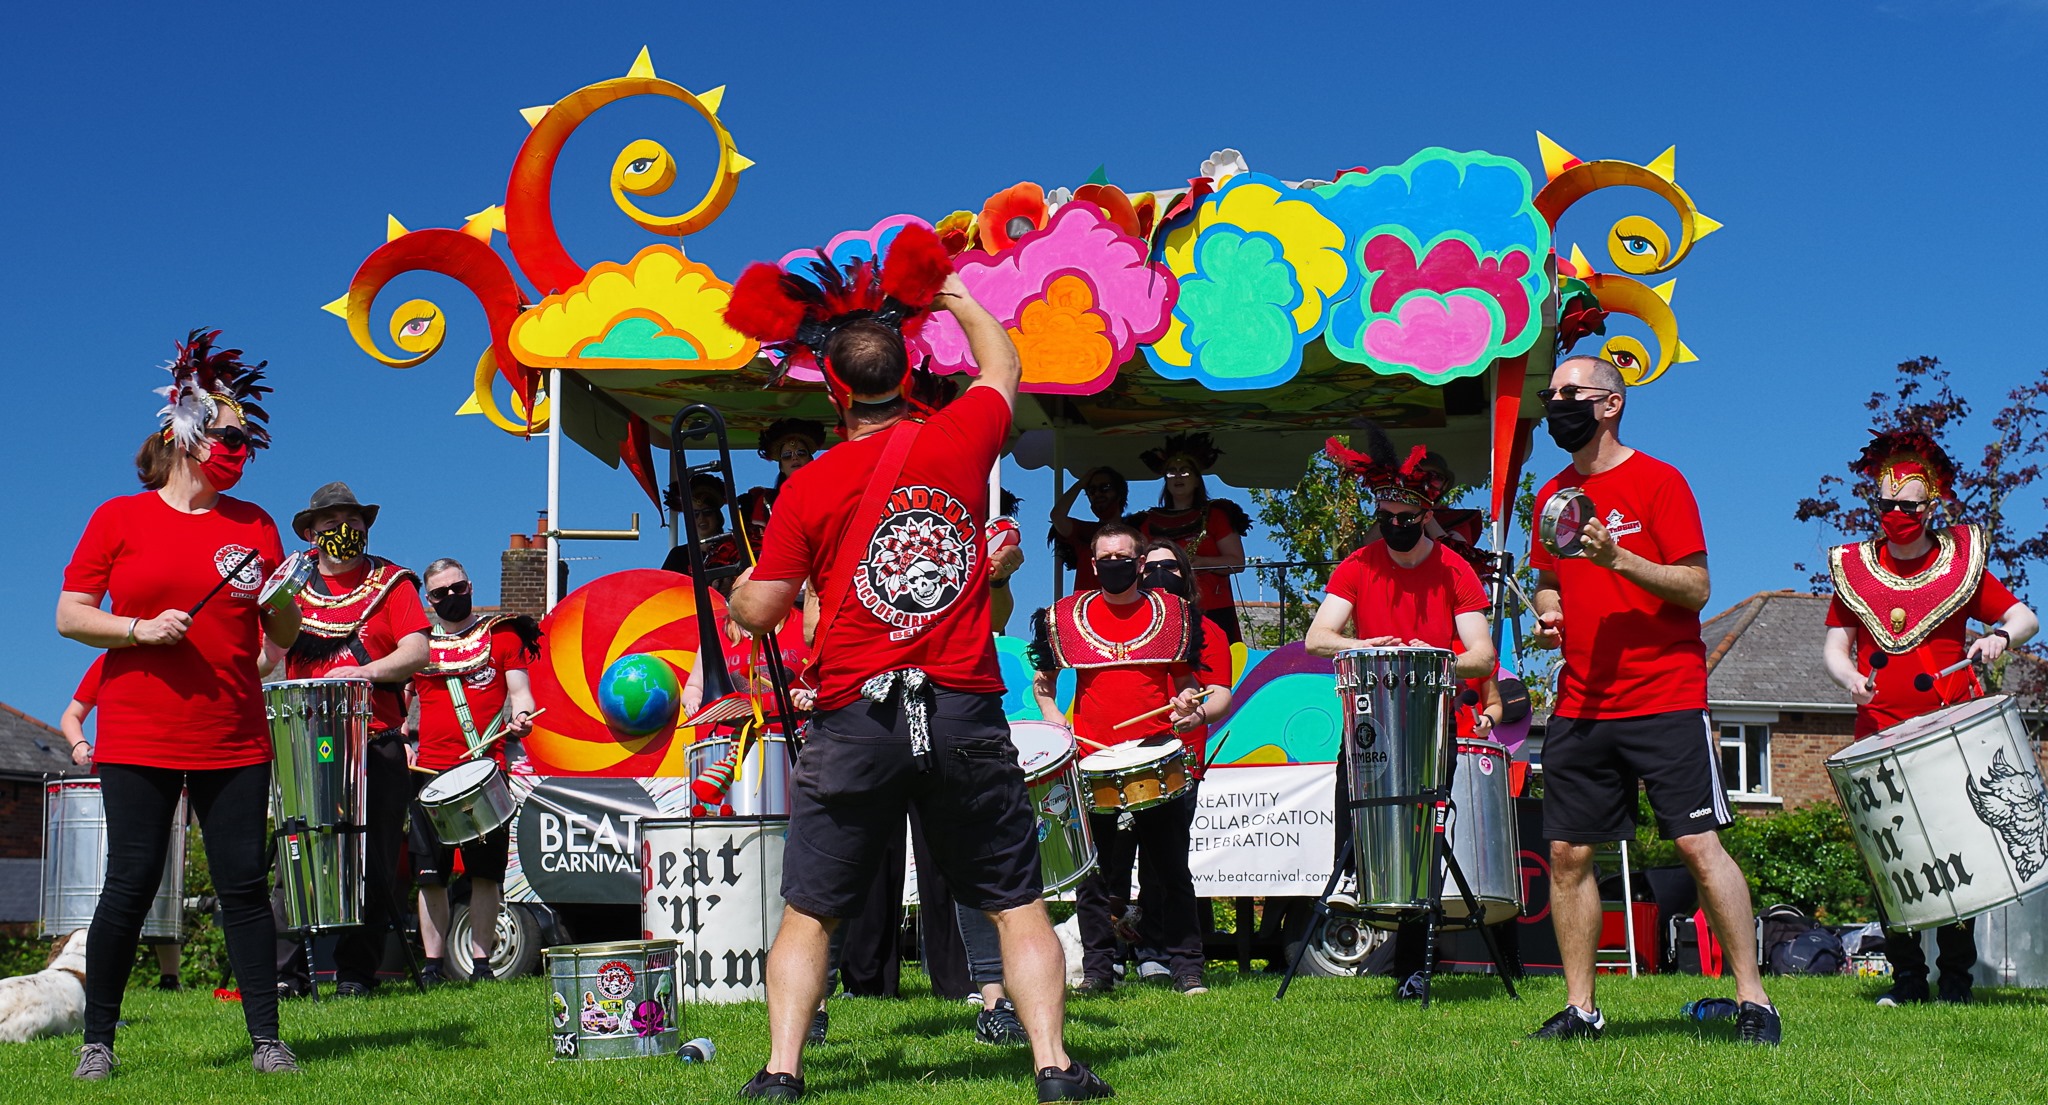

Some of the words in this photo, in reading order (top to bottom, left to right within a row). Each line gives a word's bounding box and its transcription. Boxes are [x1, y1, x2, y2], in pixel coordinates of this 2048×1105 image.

[854, 567, 878, 607] BLOCO
[874, 602, 894, 619] DE
[1841, 758, 1905, 815] eat
[1196, 792, 1280, 809] REATIVITY
[1190, 810, 1334, 831] OLLABORATION
[1689, 807, 1712, 819] adidas
[540, 812, 643, 854] BEAT
[541, 853, 641, 873] CARNIVAL
[1192, 868, 1332, 883] ww.beatcarnival.com
[677, 948, 769, 989] um
